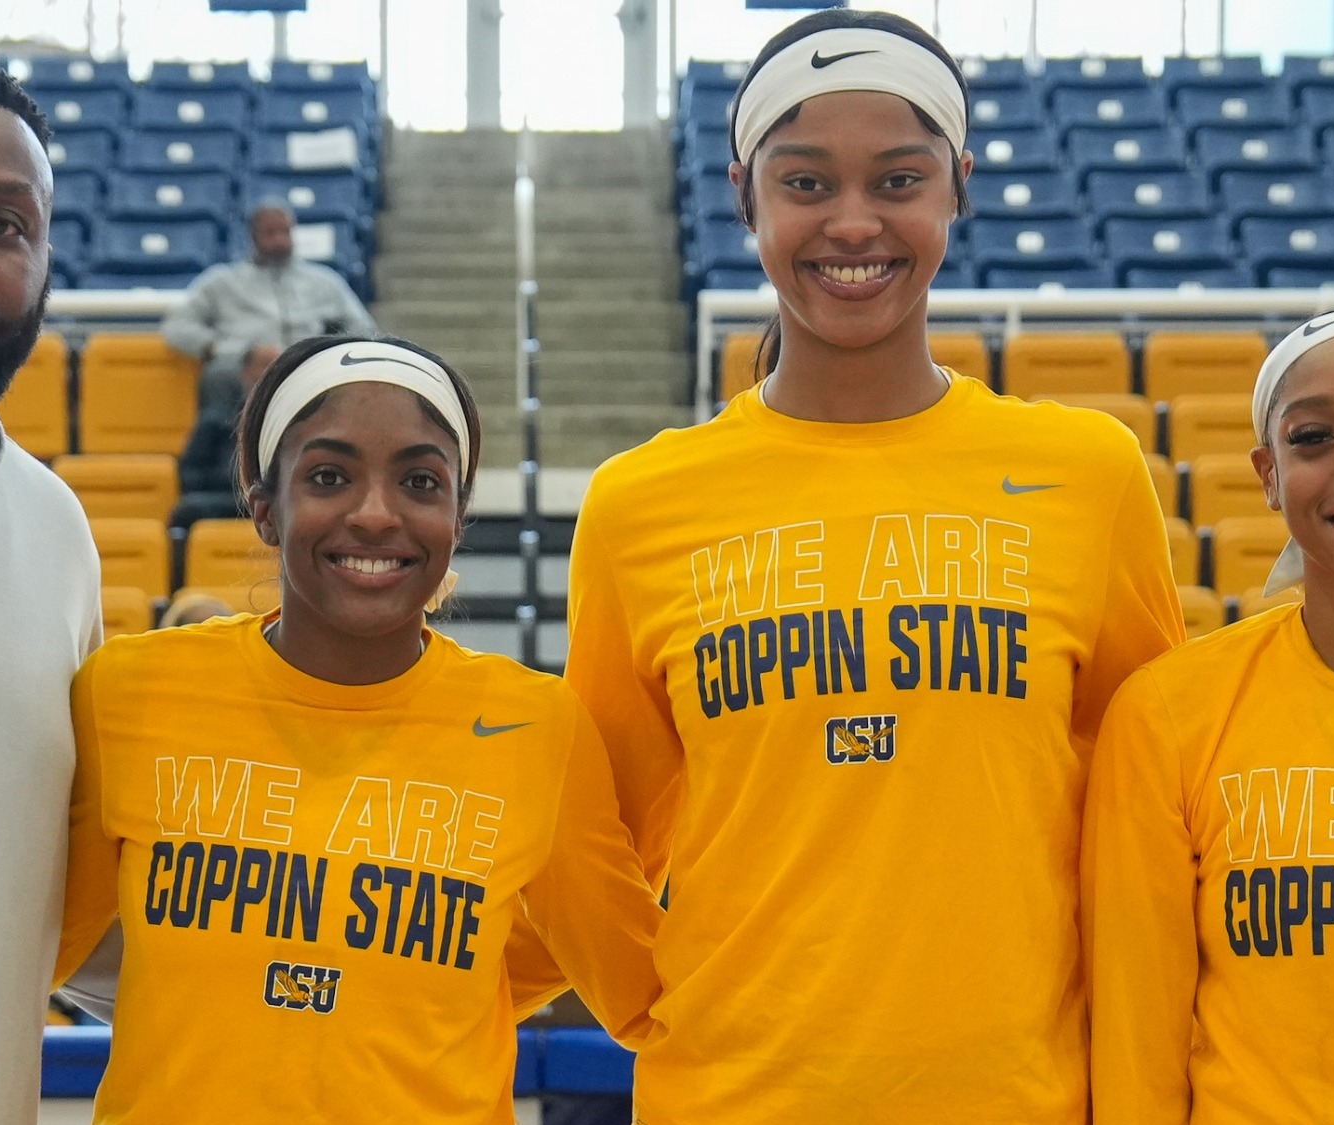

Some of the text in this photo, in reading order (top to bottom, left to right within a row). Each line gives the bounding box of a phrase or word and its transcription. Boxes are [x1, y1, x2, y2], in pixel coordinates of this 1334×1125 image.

[690, 513, 1030, 628] WE ARE
[693, 603, 1028, 719] COPPIN STATE
[824, 713, 898, 765] CSU
[155, 756, 505, 879] WE ARE
[144, 840, 486, 971] COPPIN STATE
[262, 959, 343, 1015] CSU
